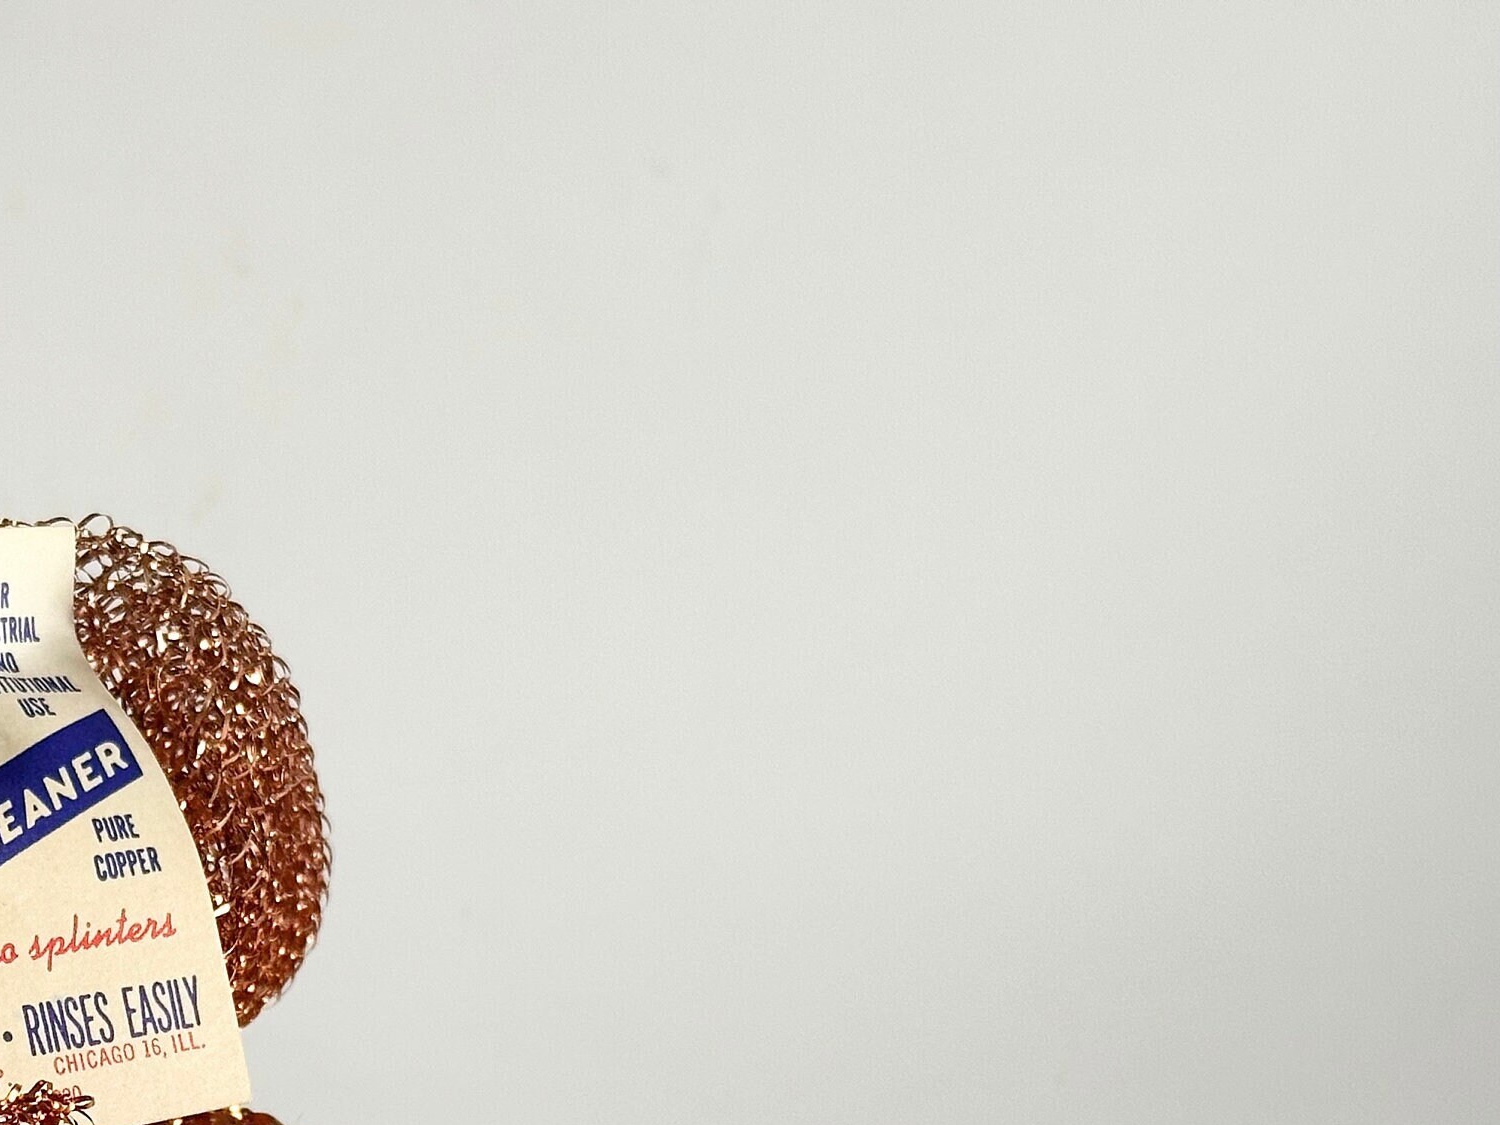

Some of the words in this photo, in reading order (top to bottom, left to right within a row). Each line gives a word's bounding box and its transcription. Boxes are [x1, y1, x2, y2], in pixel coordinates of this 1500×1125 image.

[17, 697, 56, 718] USE
[92, 814, 140, 843] PURE
[94, 847, 162, 881] COPPER
[28, 909, 177, 972] splinters
[22, 992, 114, 1056] RINSES
[125, 975, 202, 1039] EASILY
[54, 1042, 135, 1076] CHICAGO
[144, 1039, 168, 1059] 16,
[172, 1032, 206, 1053] ILL.
